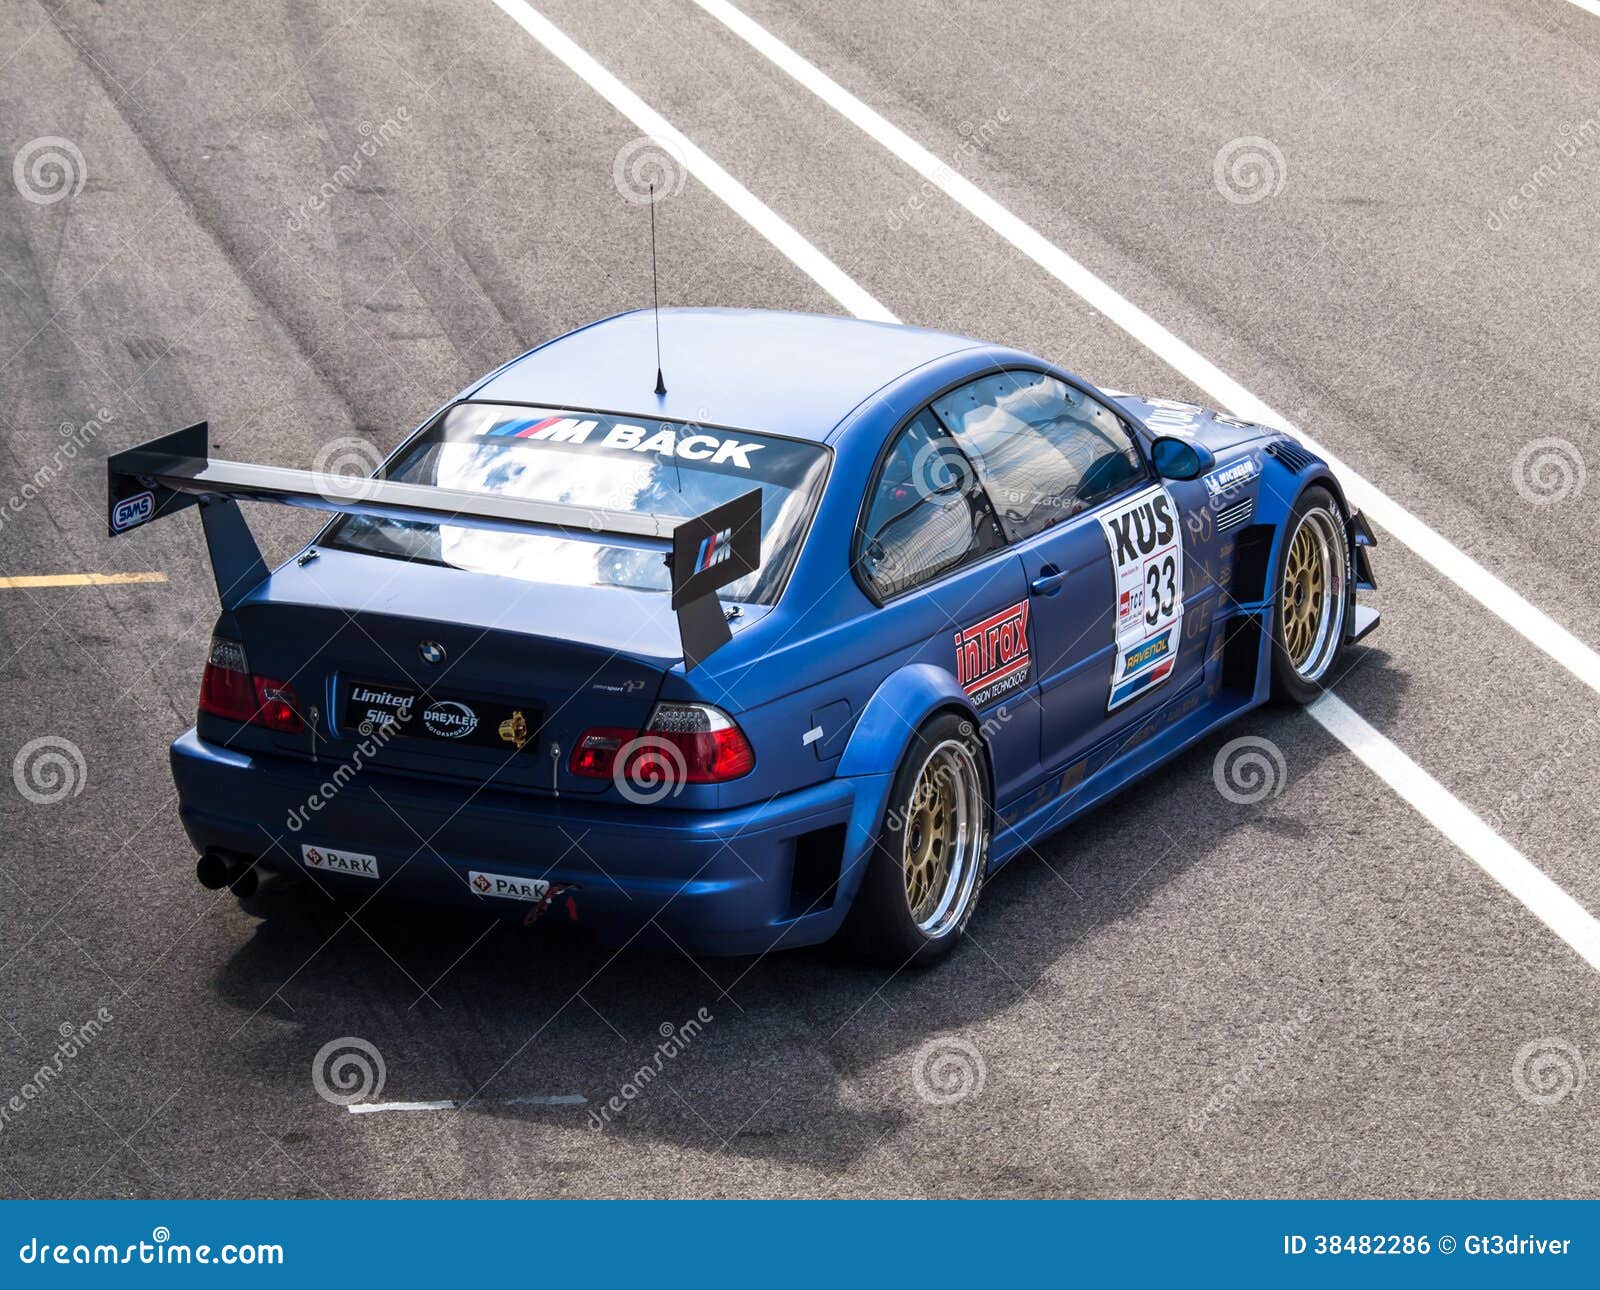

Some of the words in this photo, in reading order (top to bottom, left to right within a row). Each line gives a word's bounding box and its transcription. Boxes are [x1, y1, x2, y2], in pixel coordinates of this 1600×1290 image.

[600, 423, 766, 469] BACK
[118, 498, 149, 523] SAMS
[1108, 494, 1174, 567] KÜS
[1146, 555, 1176, 626] 33
[351, 687, 415, 709] Limited
[366, 708, 395, 727] Slip
[423, 710, 479, 728] DREXLER
